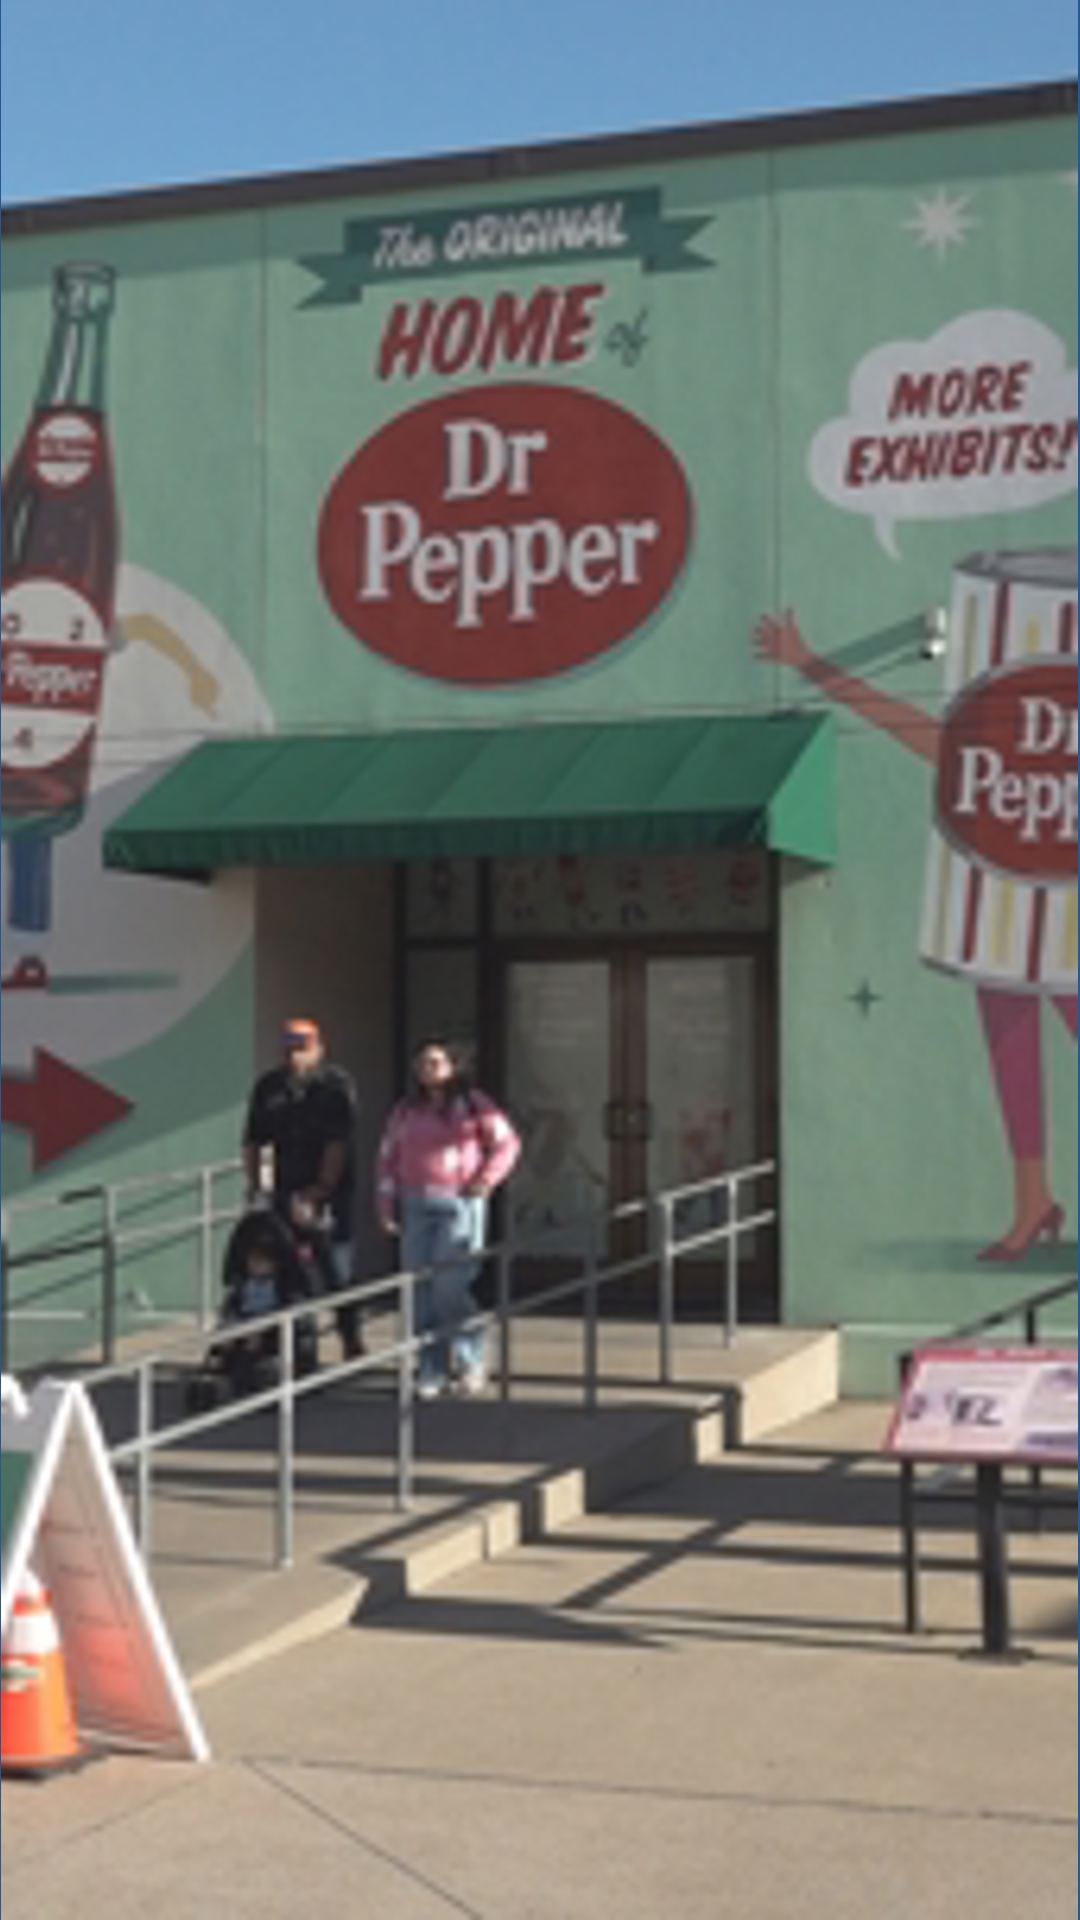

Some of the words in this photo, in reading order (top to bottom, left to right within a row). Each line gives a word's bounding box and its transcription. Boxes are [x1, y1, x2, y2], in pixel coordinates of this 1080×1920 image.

[374, 223, 435, 269] The
[444, 202, 627, 261] ORIGINAL
[377, 282, 605, 382] HOME
[606, 308, 648, 368] of
[887, 360, 1030, 423] MORE
[443, 419, 547, 500] Dr
[844, 419, 1078, 488] EXHIBITS!
[358, 502, 659, 627] Pepper
